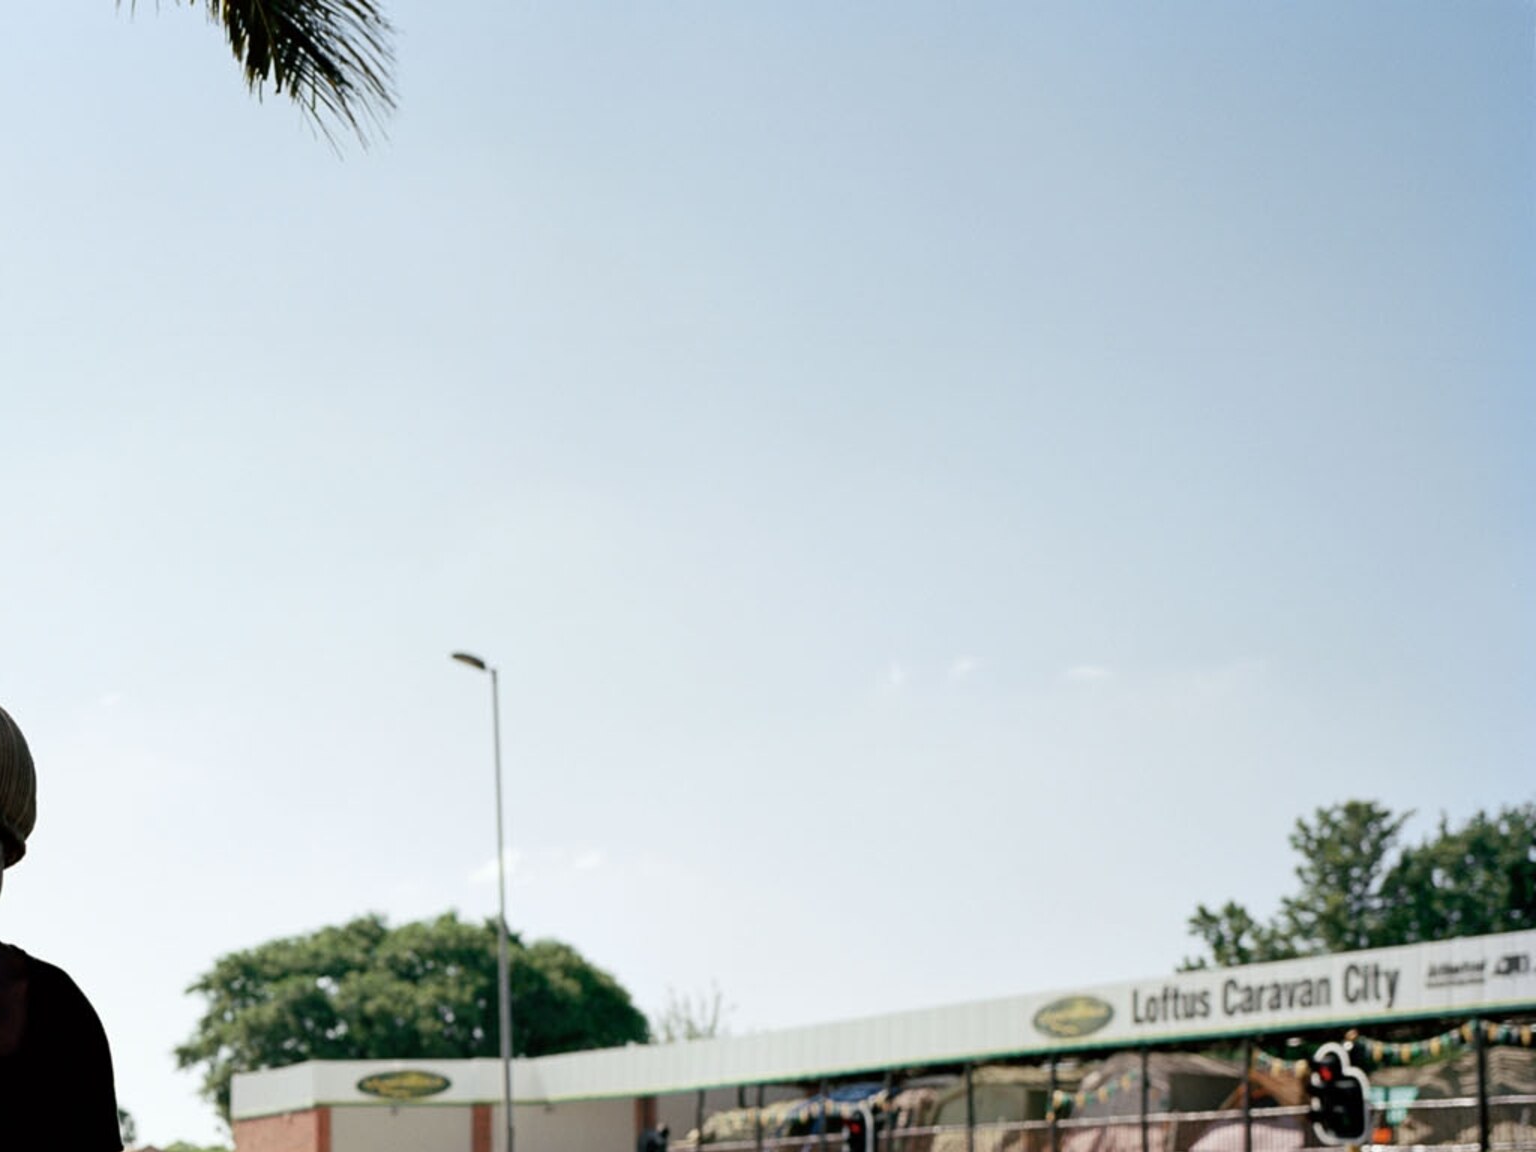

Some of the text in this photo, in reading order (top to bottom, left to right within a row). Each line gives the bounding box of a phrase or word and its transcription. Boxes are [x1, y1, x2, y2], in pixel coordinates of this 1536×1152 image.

[1132, 987, 1211, 1024] Loftus
[1223, 977, 1331, 1016] Caravan
[1343, 963, 1400, 1009] City
